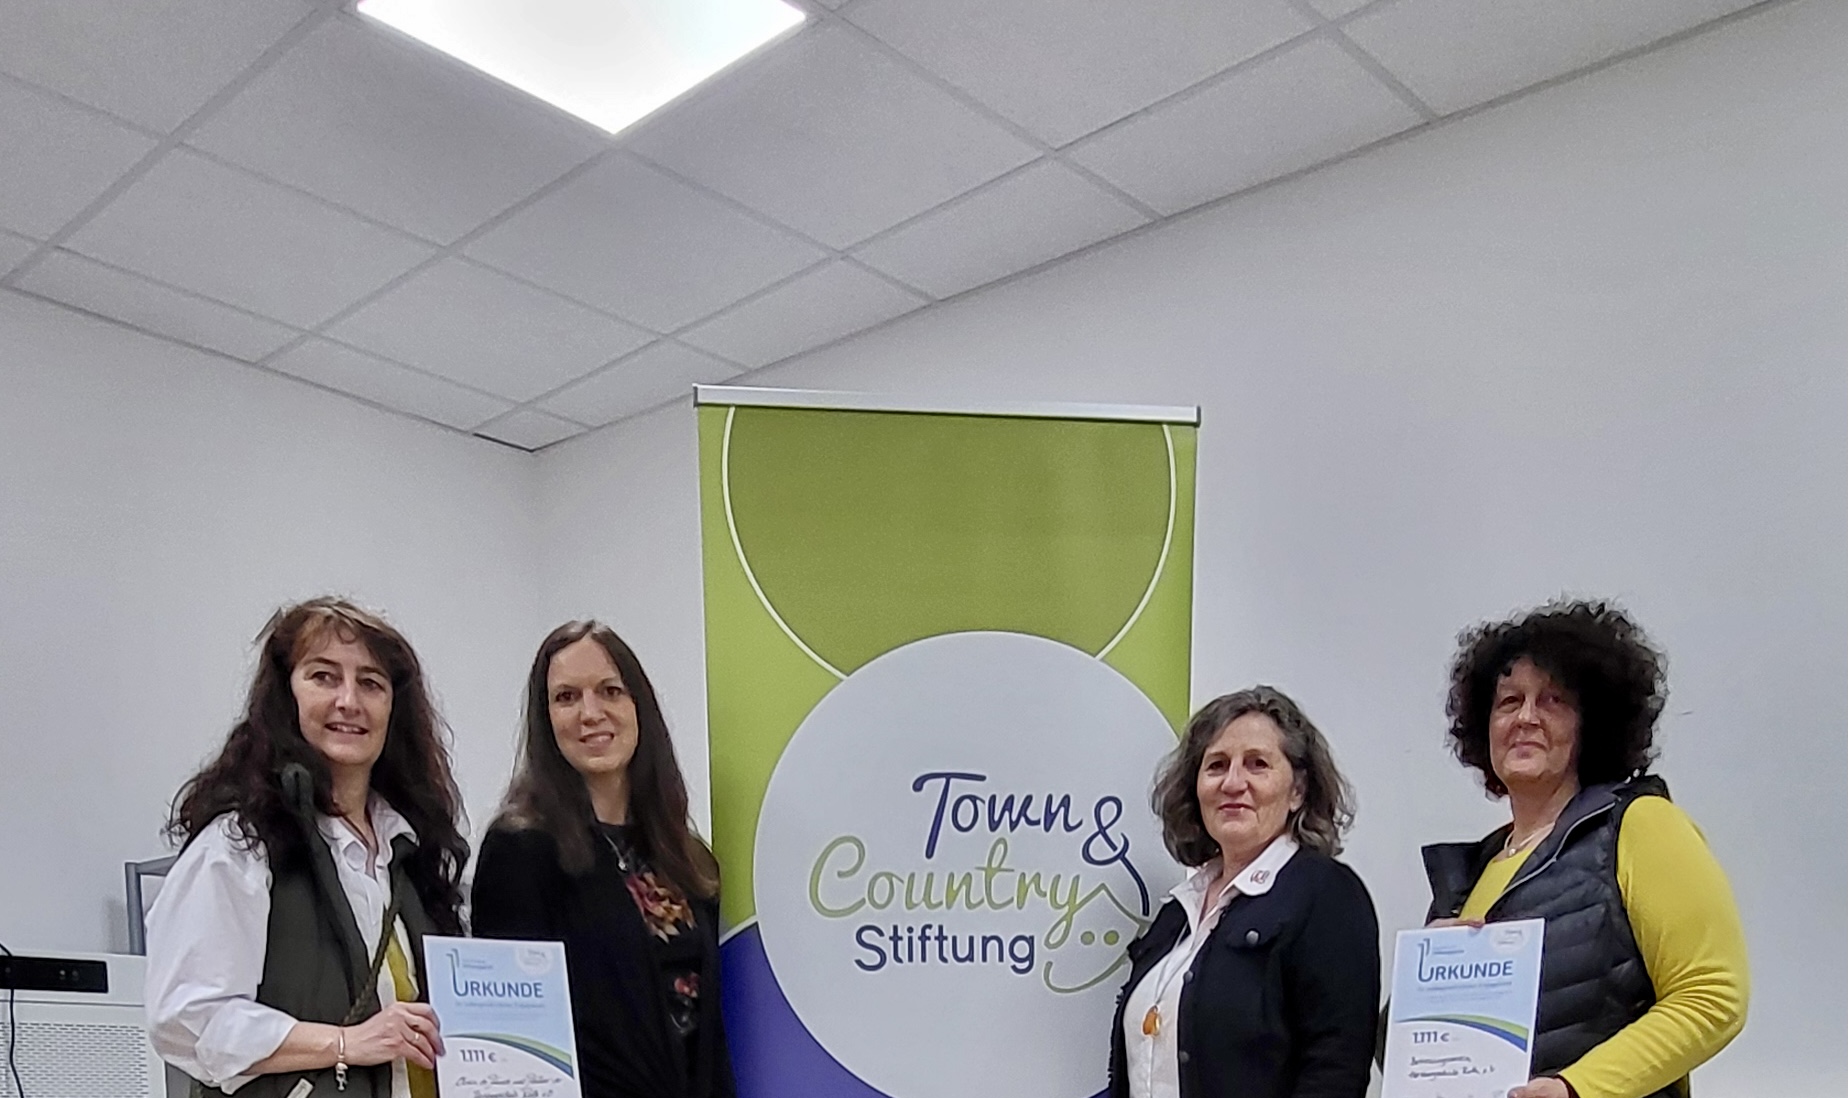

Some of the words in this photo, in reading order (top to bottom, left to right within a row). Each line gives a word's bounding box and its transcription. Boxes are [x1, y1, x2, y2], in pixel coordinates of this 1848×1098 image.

[912, 772, 1083, 859] Town
[1082, 796, 1136, 875] &
[809, 836, 1080, 949] Country
[854, 924, 1034, 974] Stiftung
[1418, 952, 1513, 982] URKUNDE
[450, 967, 544, 998] URKUNDE
